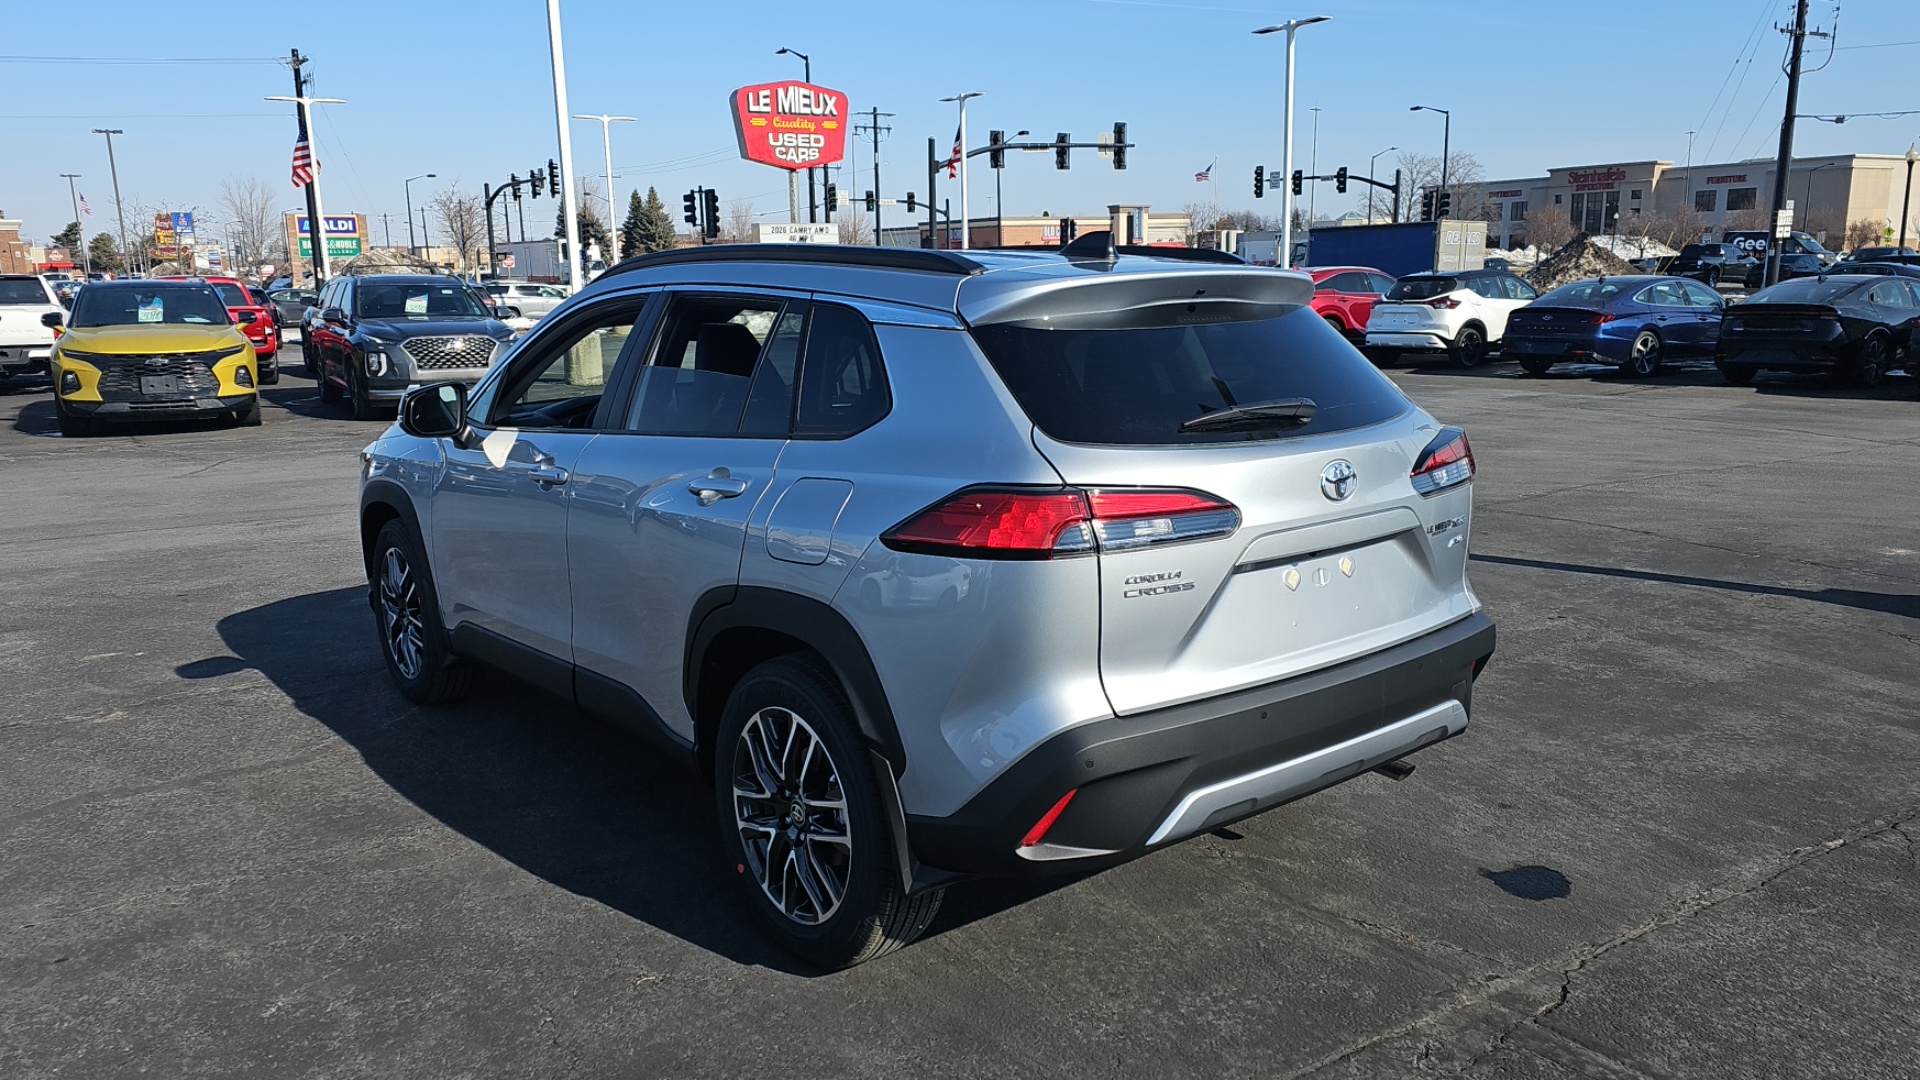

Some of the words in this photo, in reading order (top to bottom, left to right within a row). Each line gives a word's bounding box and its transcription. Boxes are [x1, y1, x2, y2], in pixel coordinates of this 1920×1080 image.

[747, 89, 772, 114] LE
[777, 86, 838, 116] MIEUX
[773, 116, 816, 133] Quality
[768, 132, 825, 148] USED
[775, 146, 820, 164] CARS
[1568, 168, 1626, 184] Steinhafels
[1706, 174, 1747, 184] FURNITURE
[1576, 182, 1615, 191] SUPERSTORE
[771, 226, 787, 234] 2026
[789, 226, 812, 234] CAMRY
[814, 226, 829, 234] AWD
[1733, 236, 1767, 250] Gee
[1124, 570, 1182, 585] COROLLA
[1123, 581, 1196, 598] CROSS
